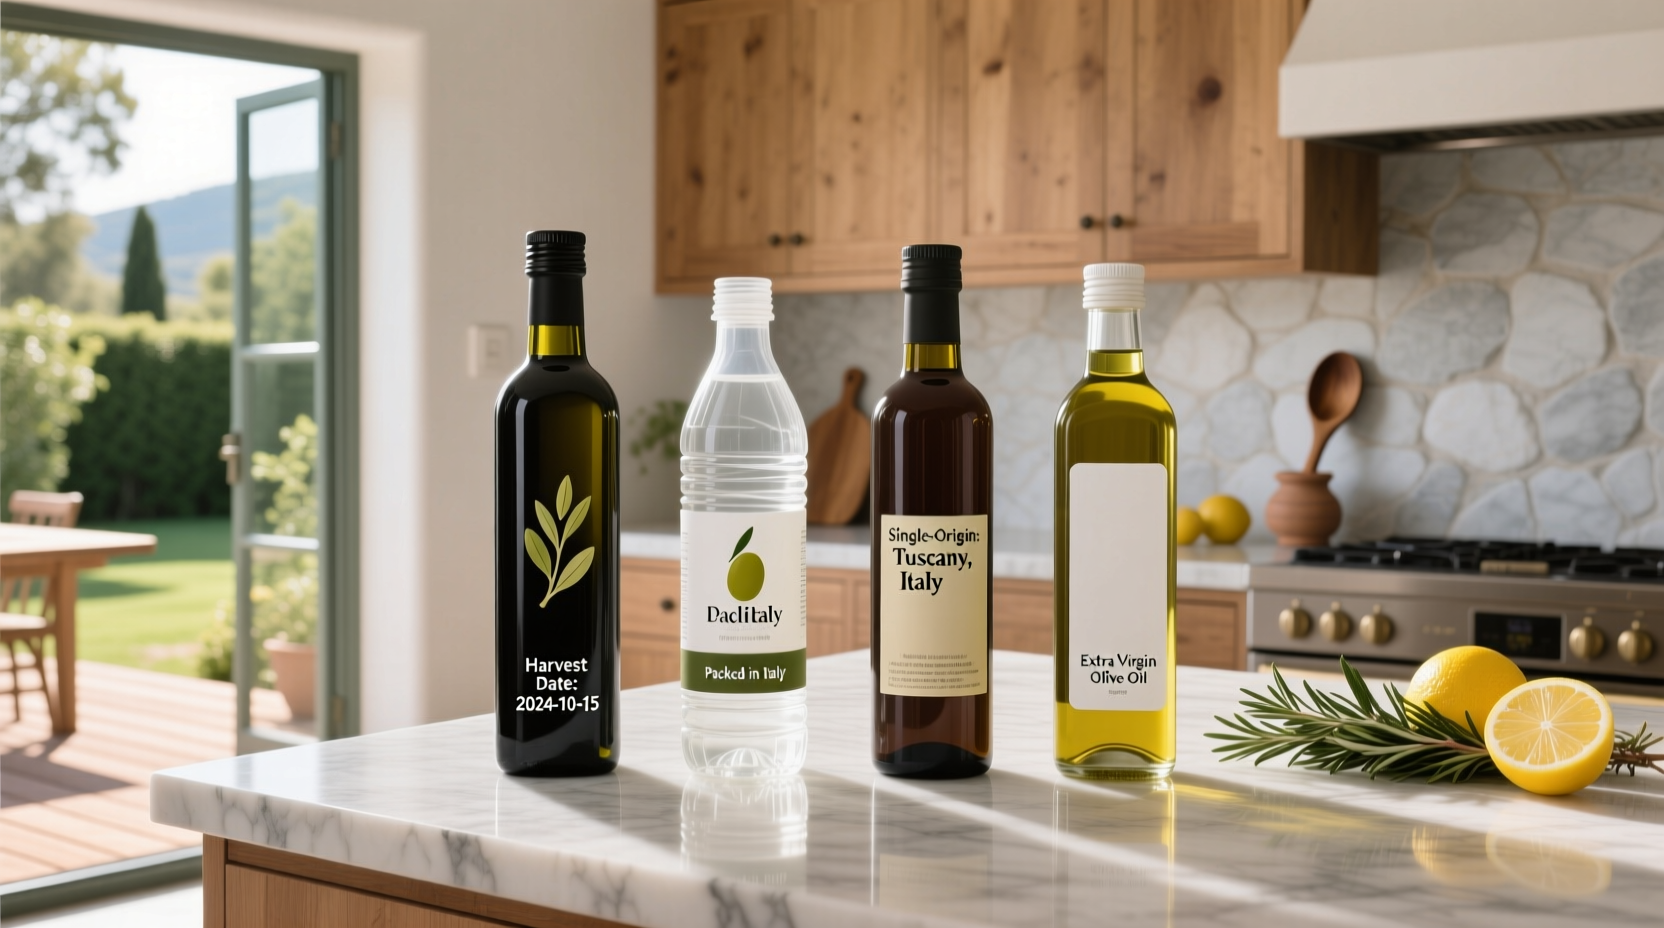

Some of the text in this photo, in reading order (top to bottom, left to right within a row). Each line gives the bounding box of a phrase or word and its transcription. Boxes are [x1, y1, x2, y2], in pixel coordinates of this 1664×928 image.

[888, 527, 980, 546] Single-Origin:
[892, 547, 973, 571] Tuscany,
[900, 571, 943, 596] Italy
[525, 657, 588, 673] Harvest
[1081, 653, 1157, 671] Extra Virgin
[749, 666, 760, 680] in
[1091, 671, 1147, 684] Olive Oil
[536, 676, 578, 691] Date:
[515, 695, 600, 712] 2024-10-15
